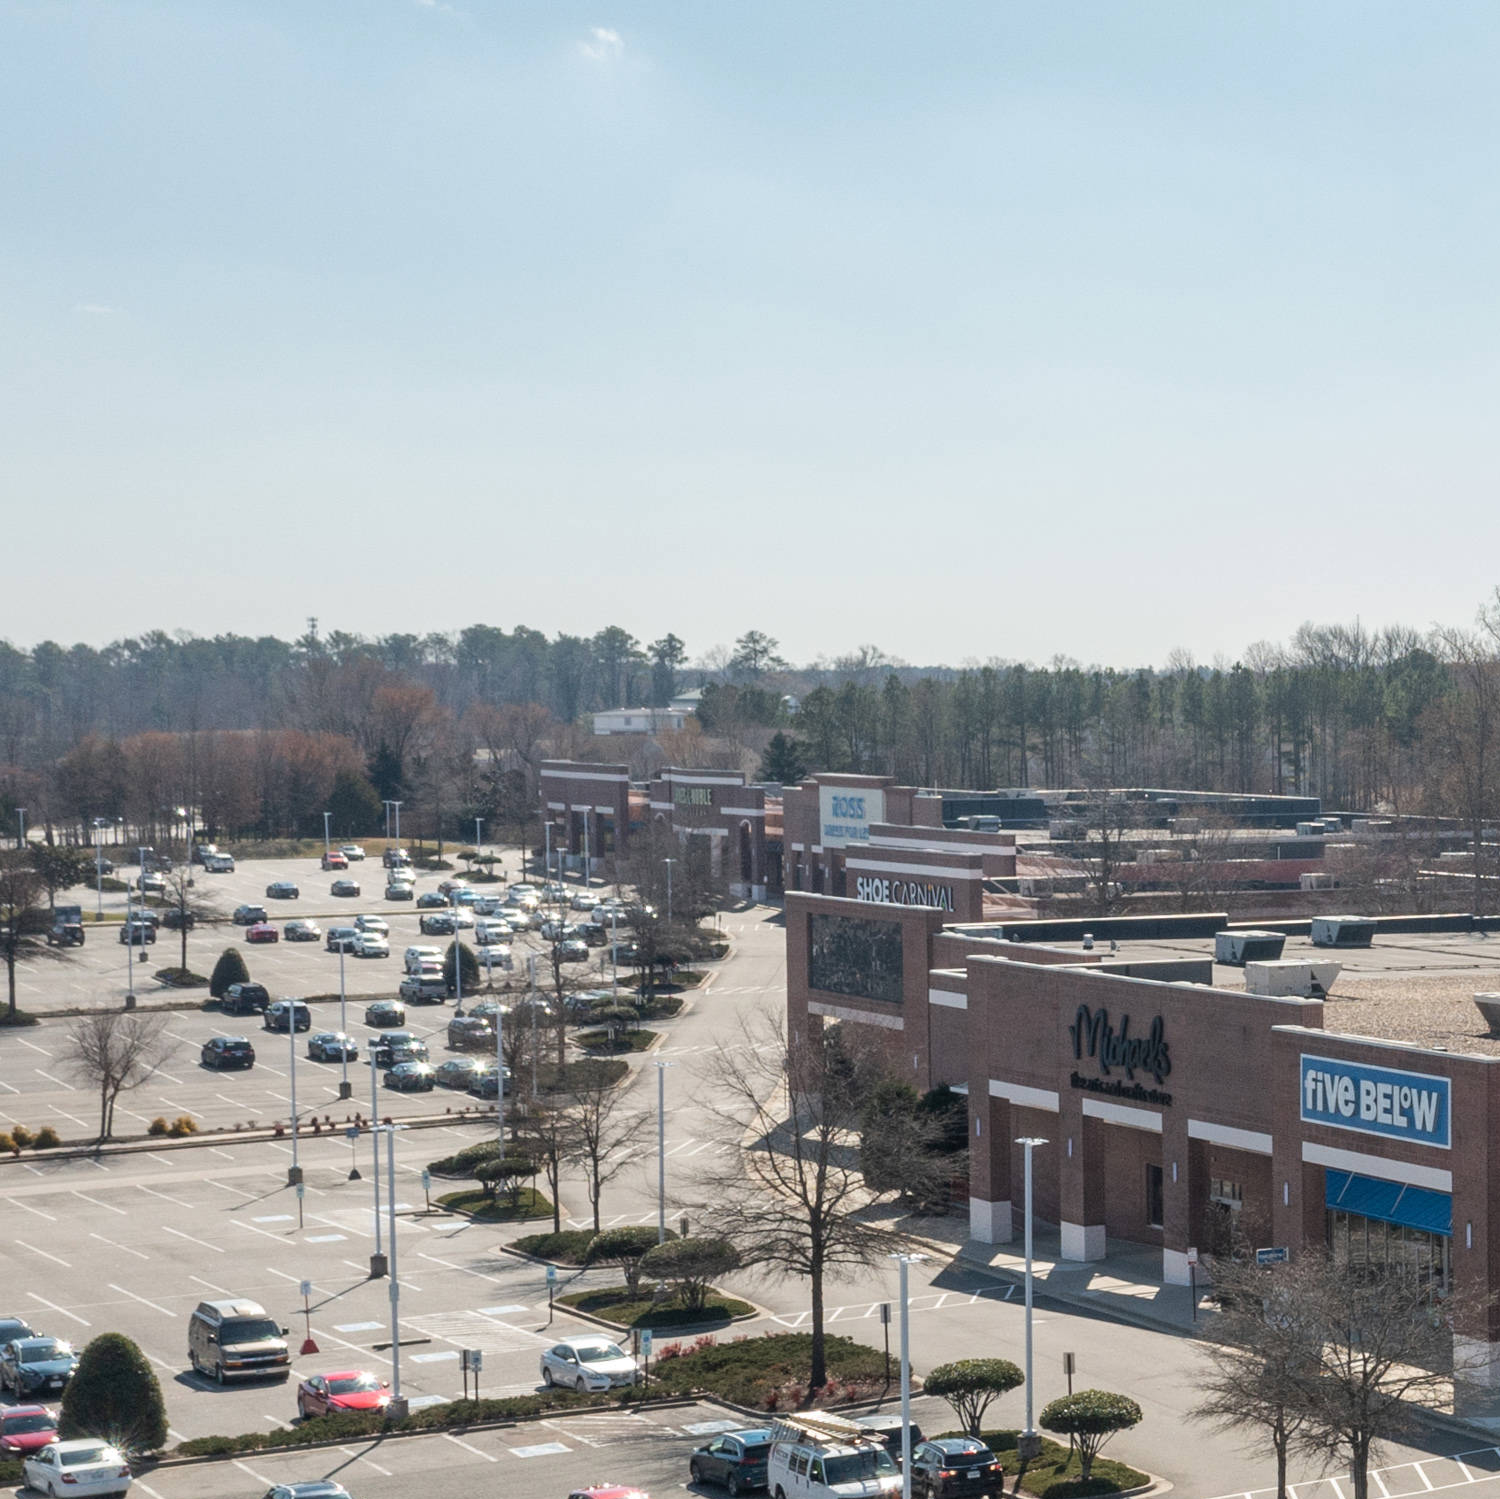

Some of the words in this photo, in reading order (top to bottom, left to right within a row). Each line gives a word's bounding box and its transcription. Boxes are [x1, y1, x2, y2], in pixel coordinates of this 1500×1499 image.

[832, 796, 864, 819] ROSS
[857, 876, 890, 903] SHOE
[1069, 1004, 1171, 1085] Michaels
